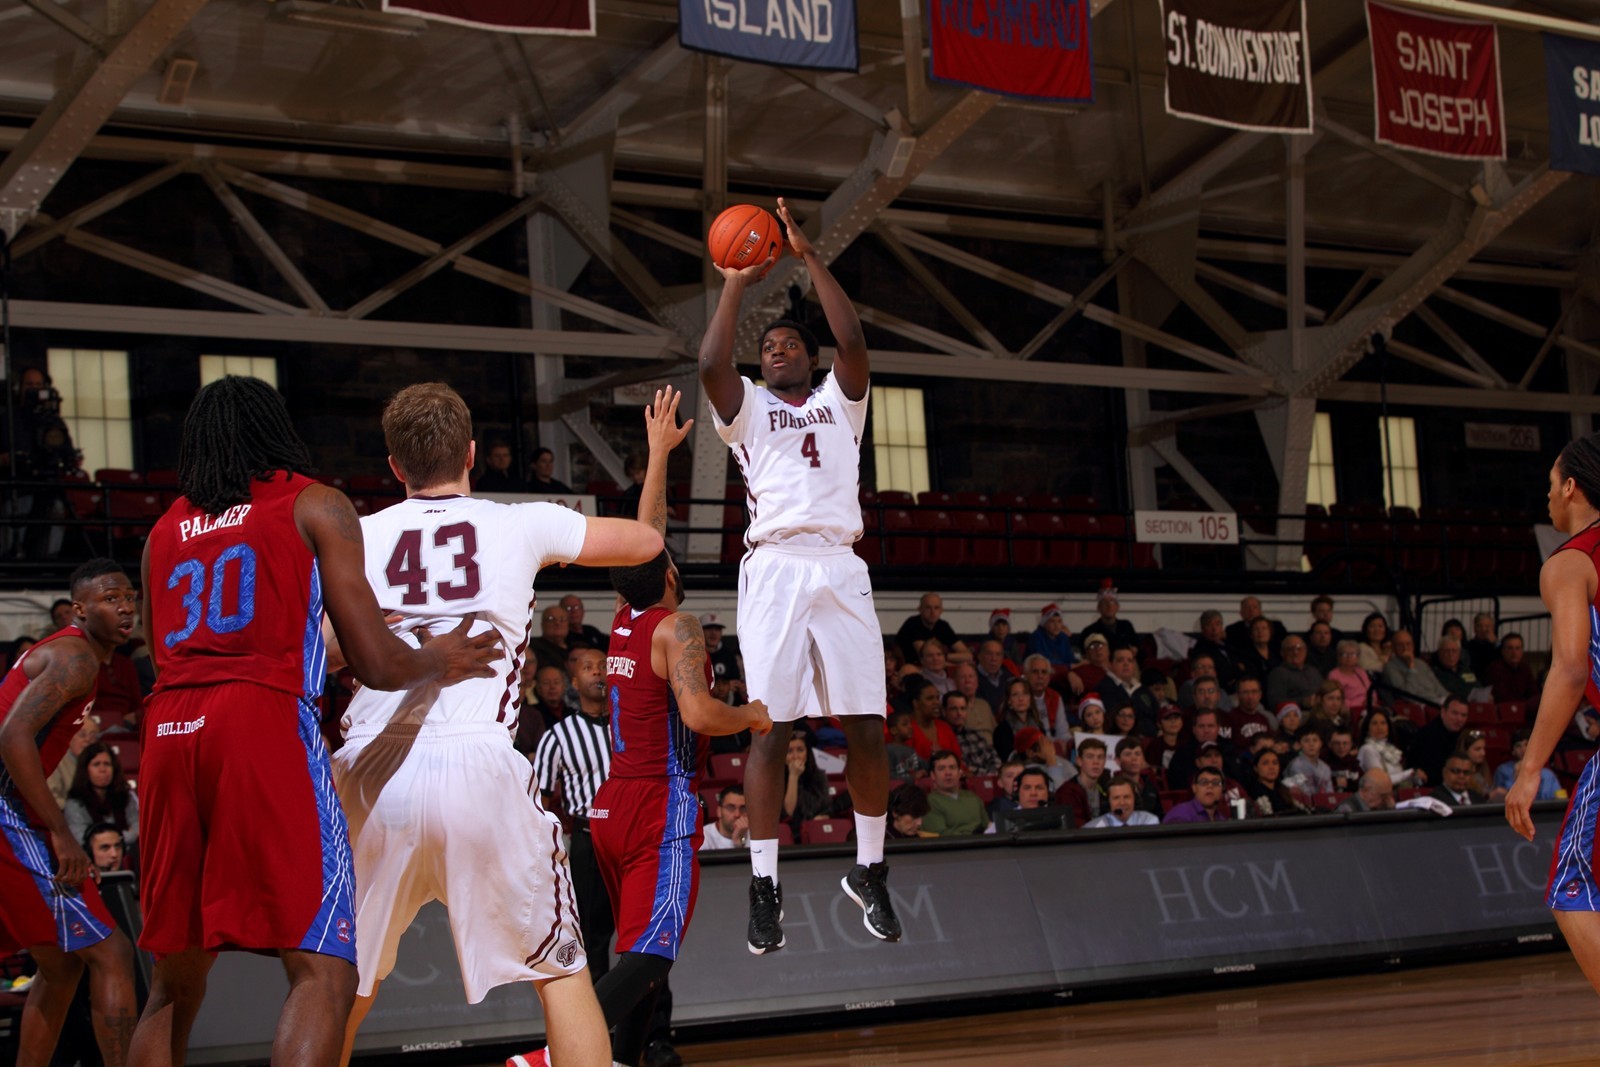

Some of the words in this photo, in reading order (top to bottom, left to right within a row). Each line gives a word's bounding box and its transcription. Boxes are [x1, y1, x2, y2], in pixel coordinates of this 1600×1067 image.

[704, 0, 833, 43] ISLAND
[941, 0, 1080, 50] RICHMOND
[1195, 19, 1300, 84] BONAVENTURE
[1396, 30, 1472, 80] SAINT
[1389, 87, 1492, 136] JOSEPH
[801, 432, 821, 468] 4
[1509, 427, 1535, 448] 206
[178, 504, 252, 542] PALMER
[1144, 518, 1193, 534] SECTION
[1197, 515, 1230, 541] 105
[383, 520, 482, 606] 43
[164, 542, 257, 649] 30
[156, 715, 206, 737] BULLDOGS
[1143, 859, 1304, 924] HCM
[402, 1040, 463, 1052] DAKTRONICS
